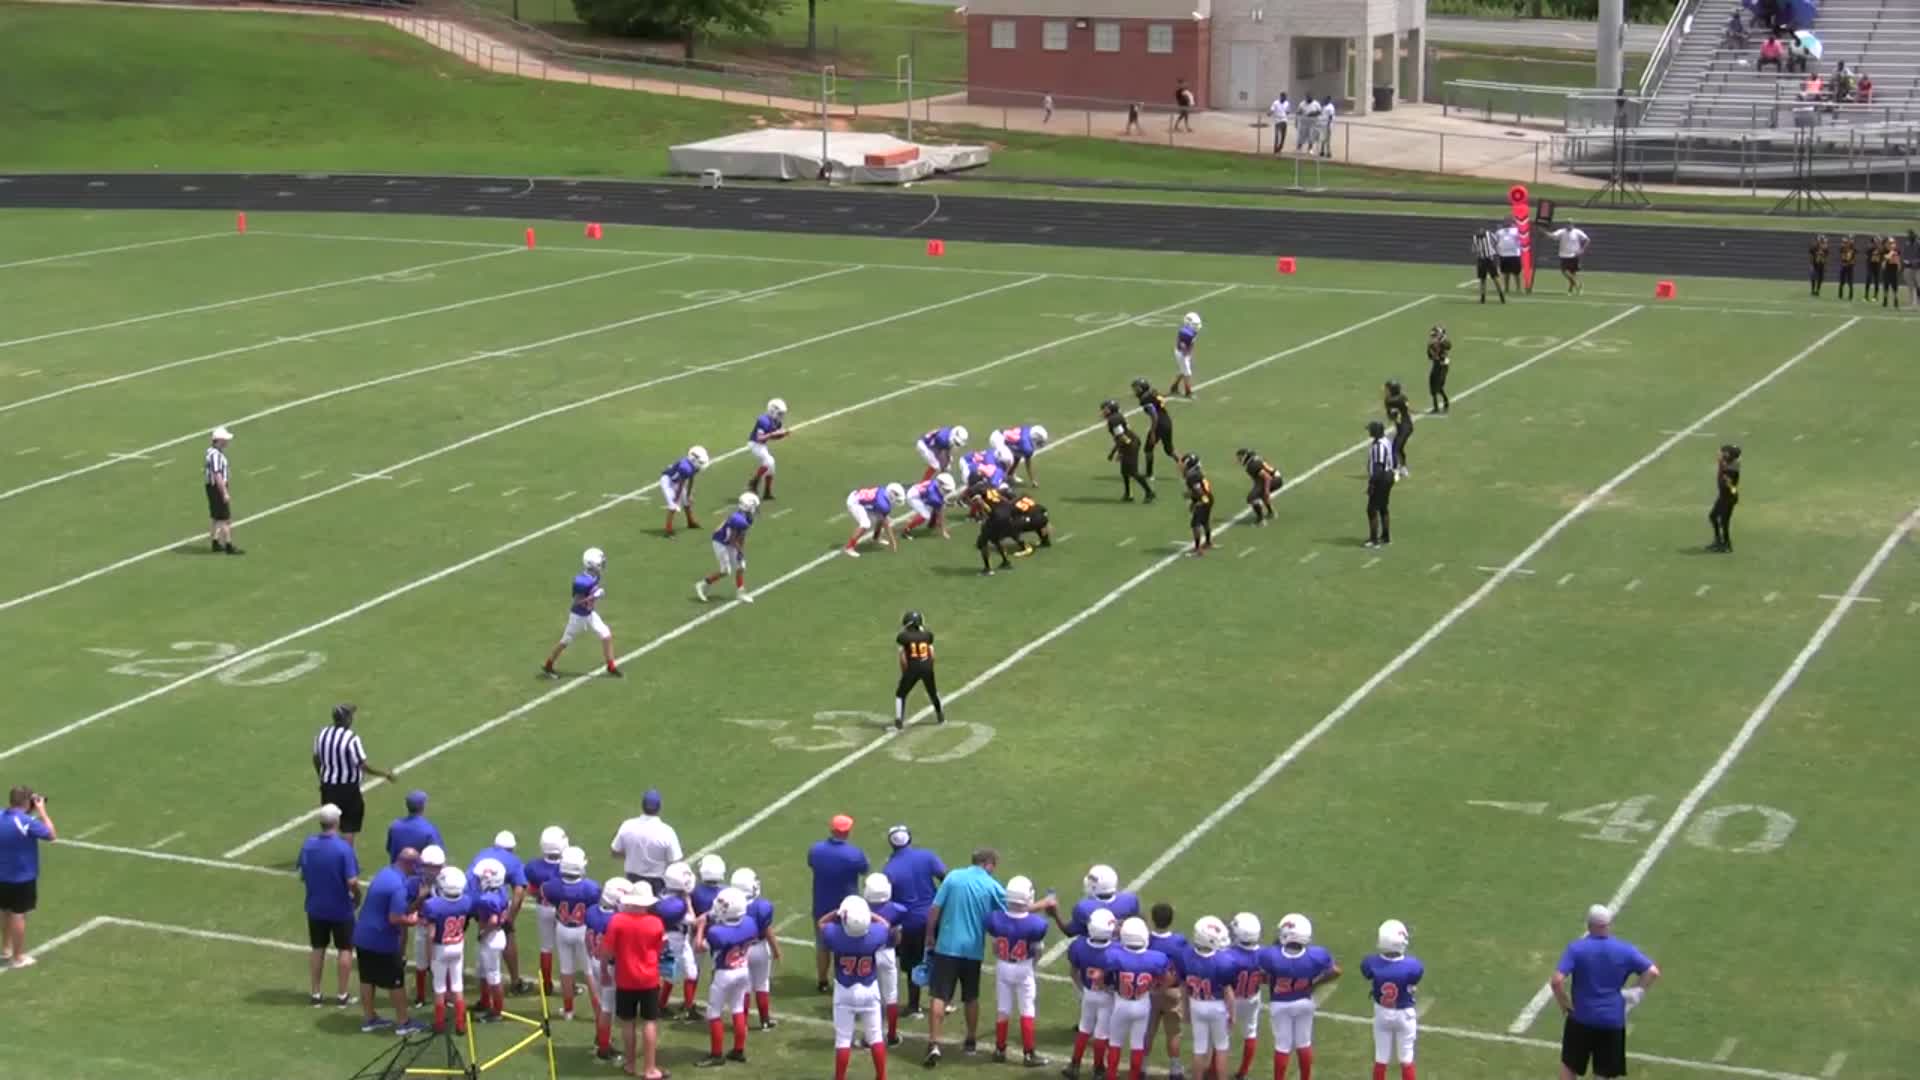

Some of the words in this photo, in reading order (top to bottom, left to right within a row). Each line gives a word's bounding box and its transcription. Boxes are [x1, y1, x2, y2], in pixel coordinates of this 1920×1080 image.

[106, 640, 326, 687] 20
[770, 710, 997, 763] 30
[1553, 794, 1797, 853] 40
